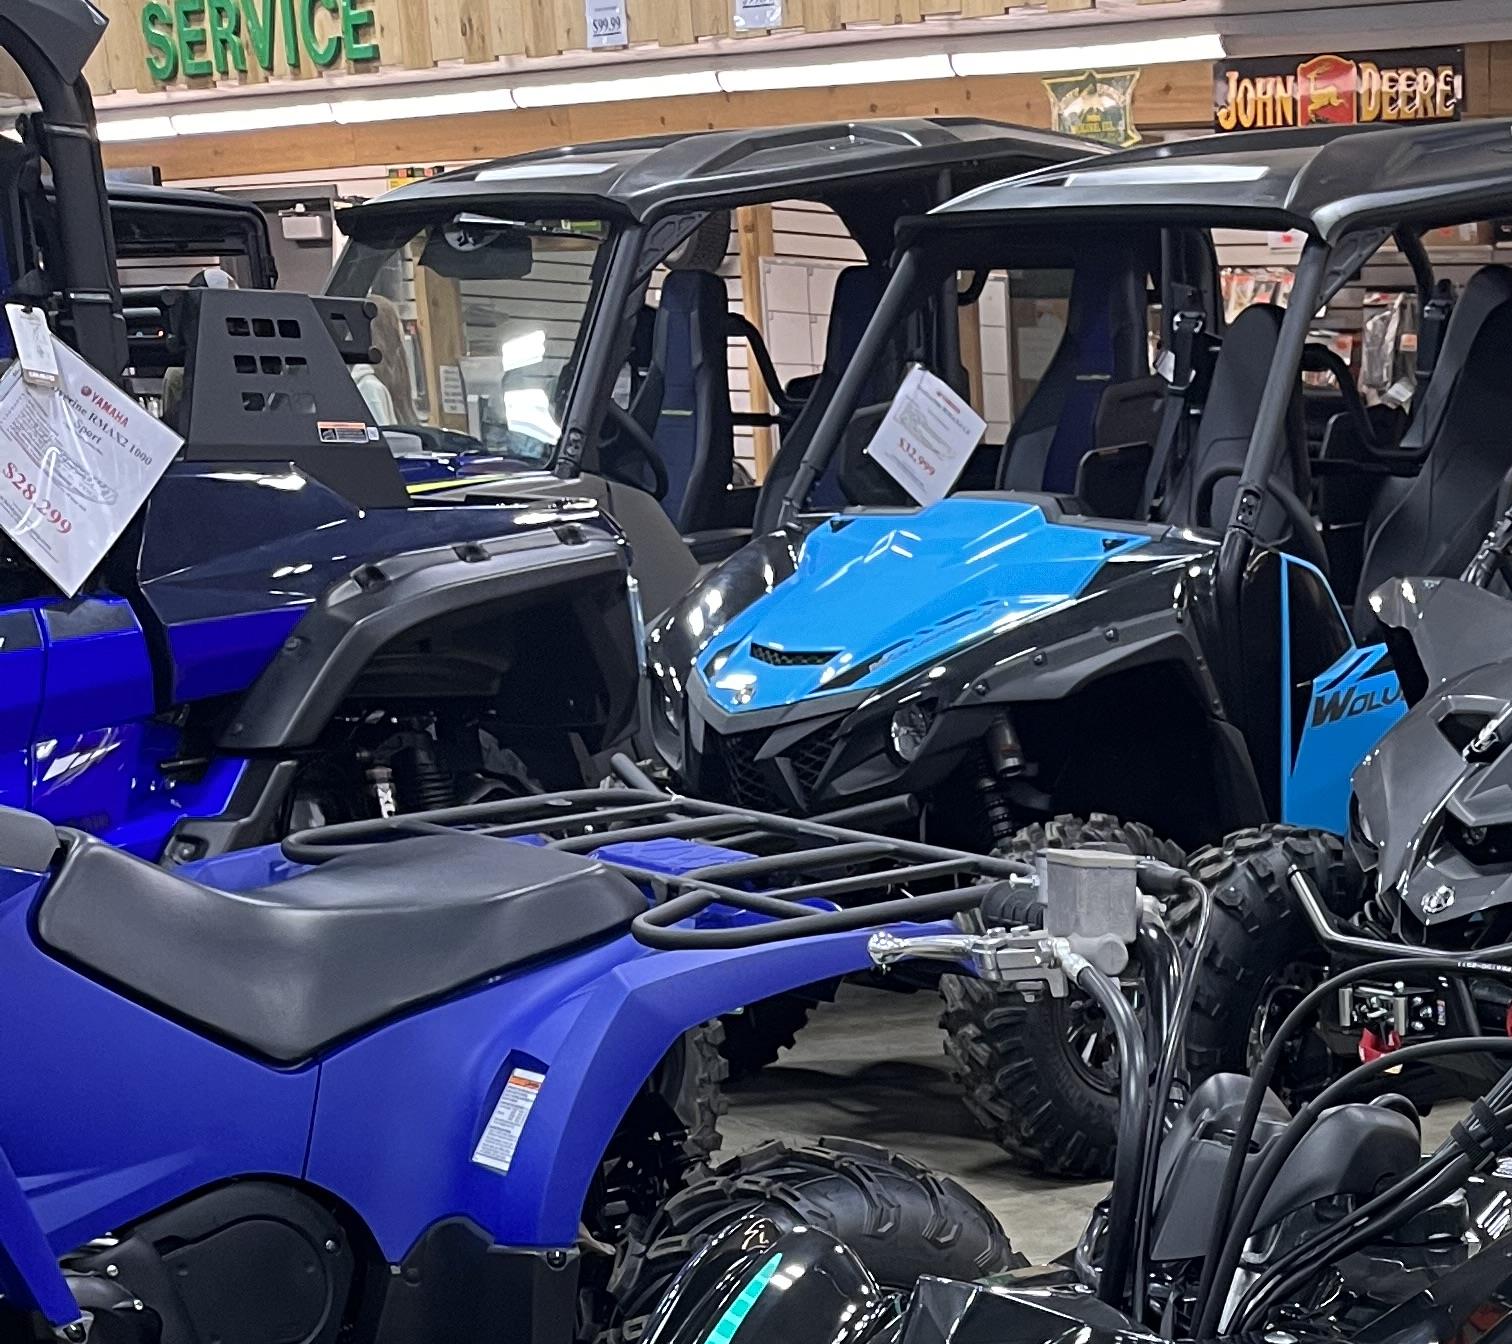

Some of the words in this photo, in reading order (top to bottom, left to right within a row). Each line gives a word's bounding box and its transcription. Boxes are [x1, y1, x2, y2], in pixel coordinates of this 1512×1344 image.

[142, 0, 380, 80] SERVICE
[592, 16, 621, 34] $99.99
[1217, 71, 1296, 130] JOHN
[1359, 61, 1460, 122] DEERE
[91, 391, 129, 428] YAMAHA
